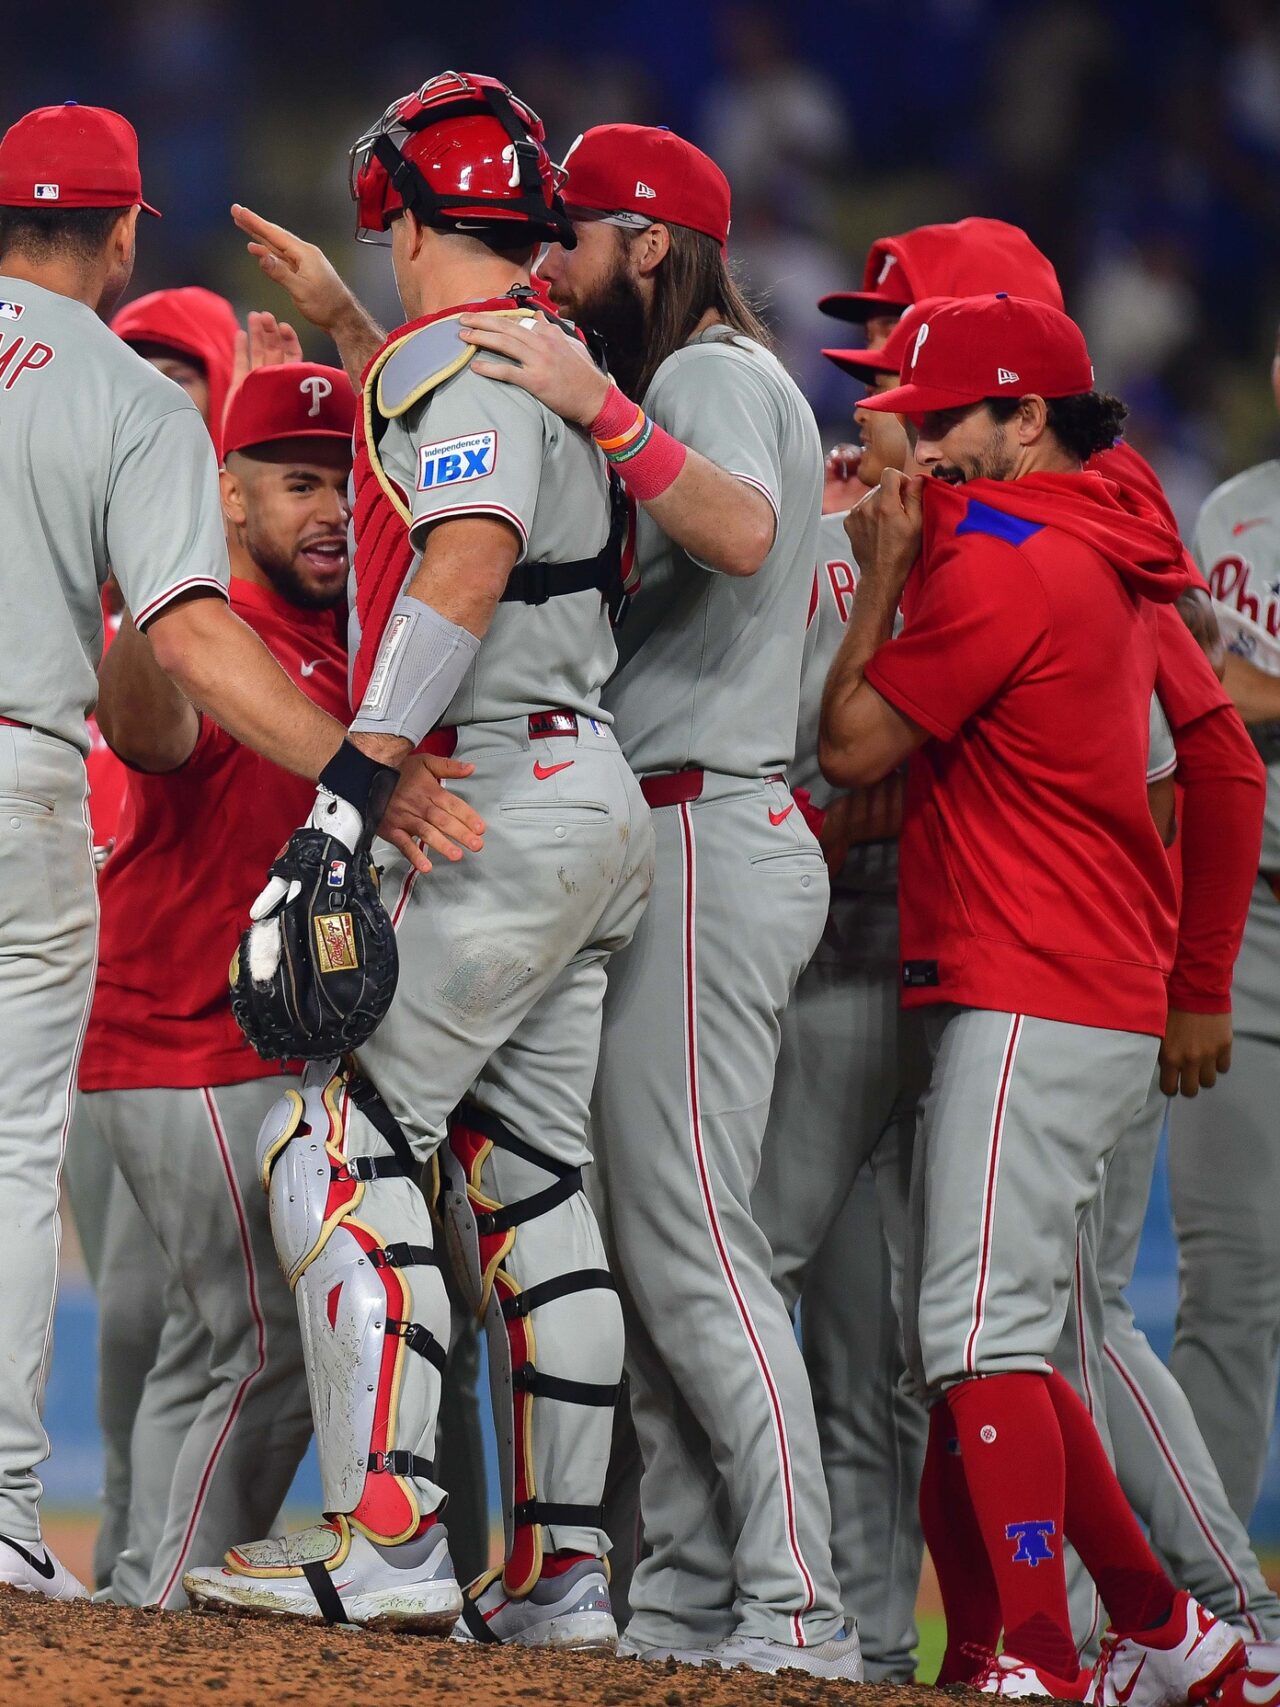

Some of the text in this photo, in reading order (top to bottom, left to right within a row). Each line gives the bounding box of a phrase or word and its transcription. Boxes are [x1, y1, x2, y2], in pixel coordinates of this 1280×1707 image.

[300, 376, 332, 417] P
[423, 447, 490, 487] IBX
[424, 438, 480, 457] Independence
